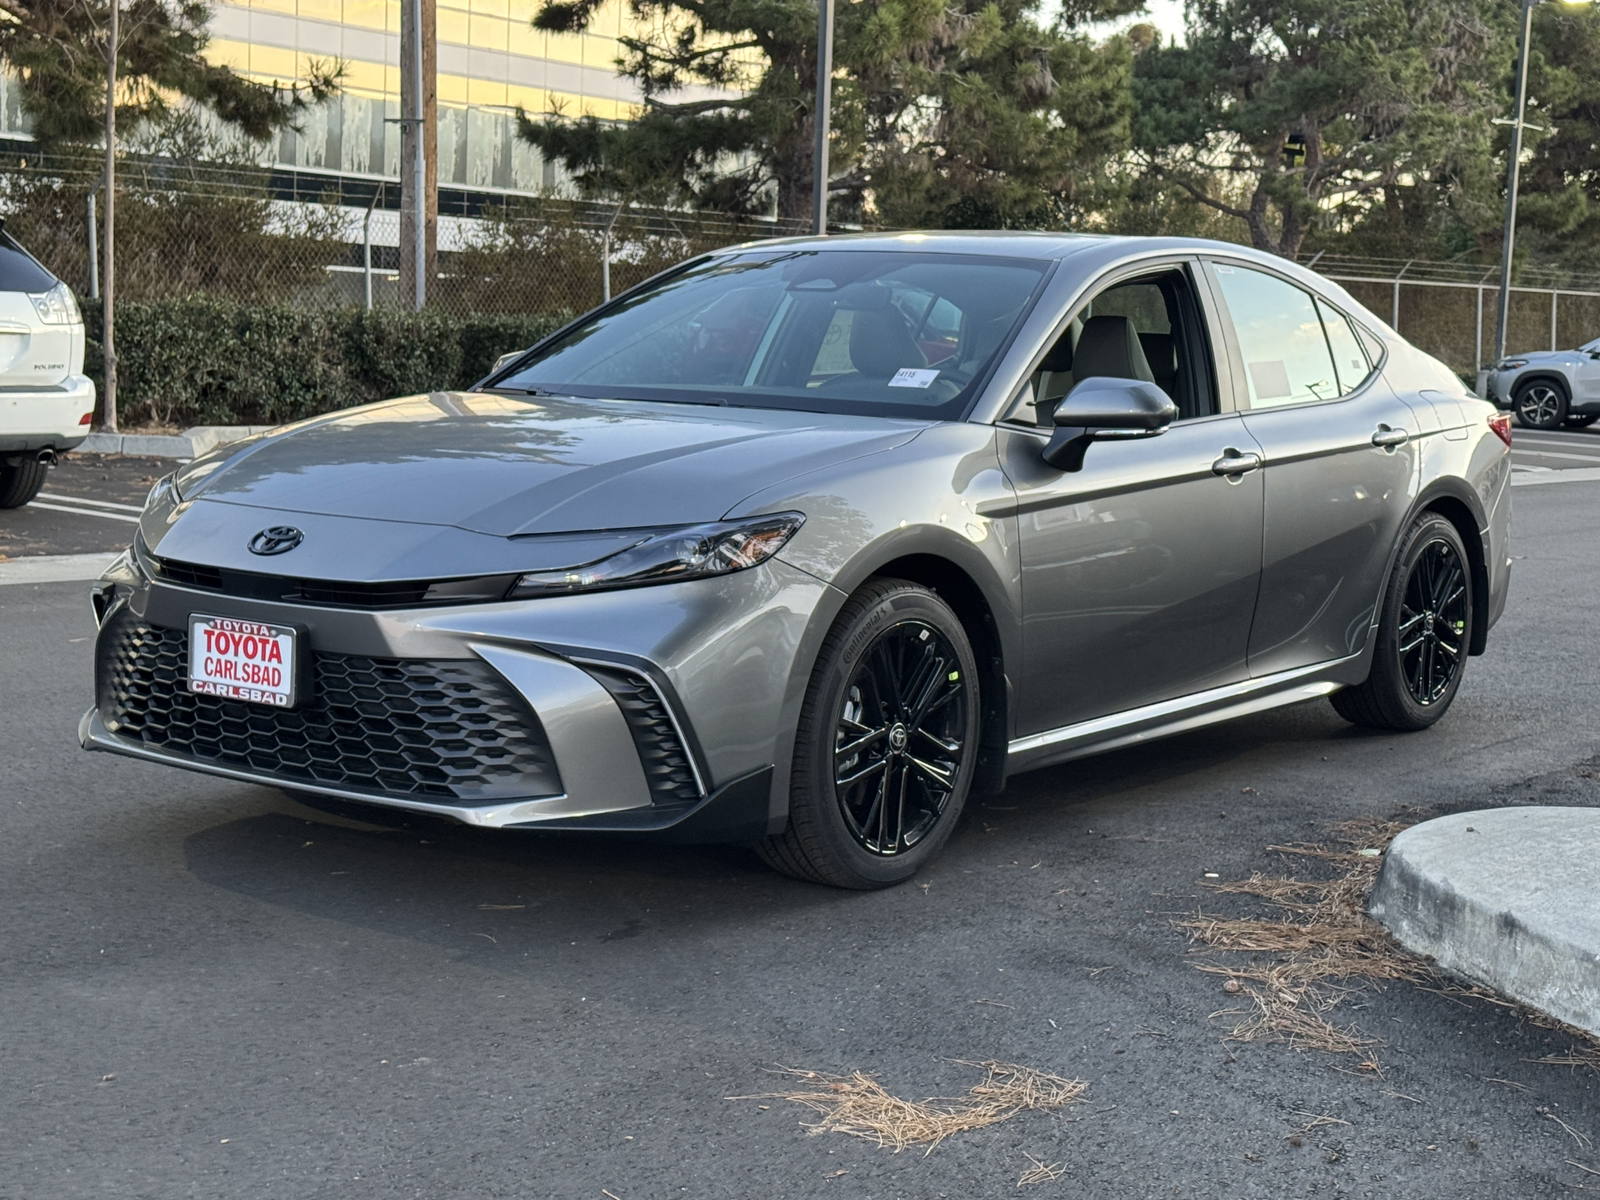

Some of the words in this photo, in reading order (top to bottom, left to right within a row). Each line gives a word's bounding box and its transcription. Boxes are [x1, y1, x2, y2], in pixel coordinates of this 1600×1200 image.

[214, 619, 269, 636] TOYOTA
[843, 610, 881, 664] Continental
[204, 629, 282, 664] TOYOTA
[204, 656, 281, 687] CARLSBAD
[192, 680, 287, 705] CARLSBAD
